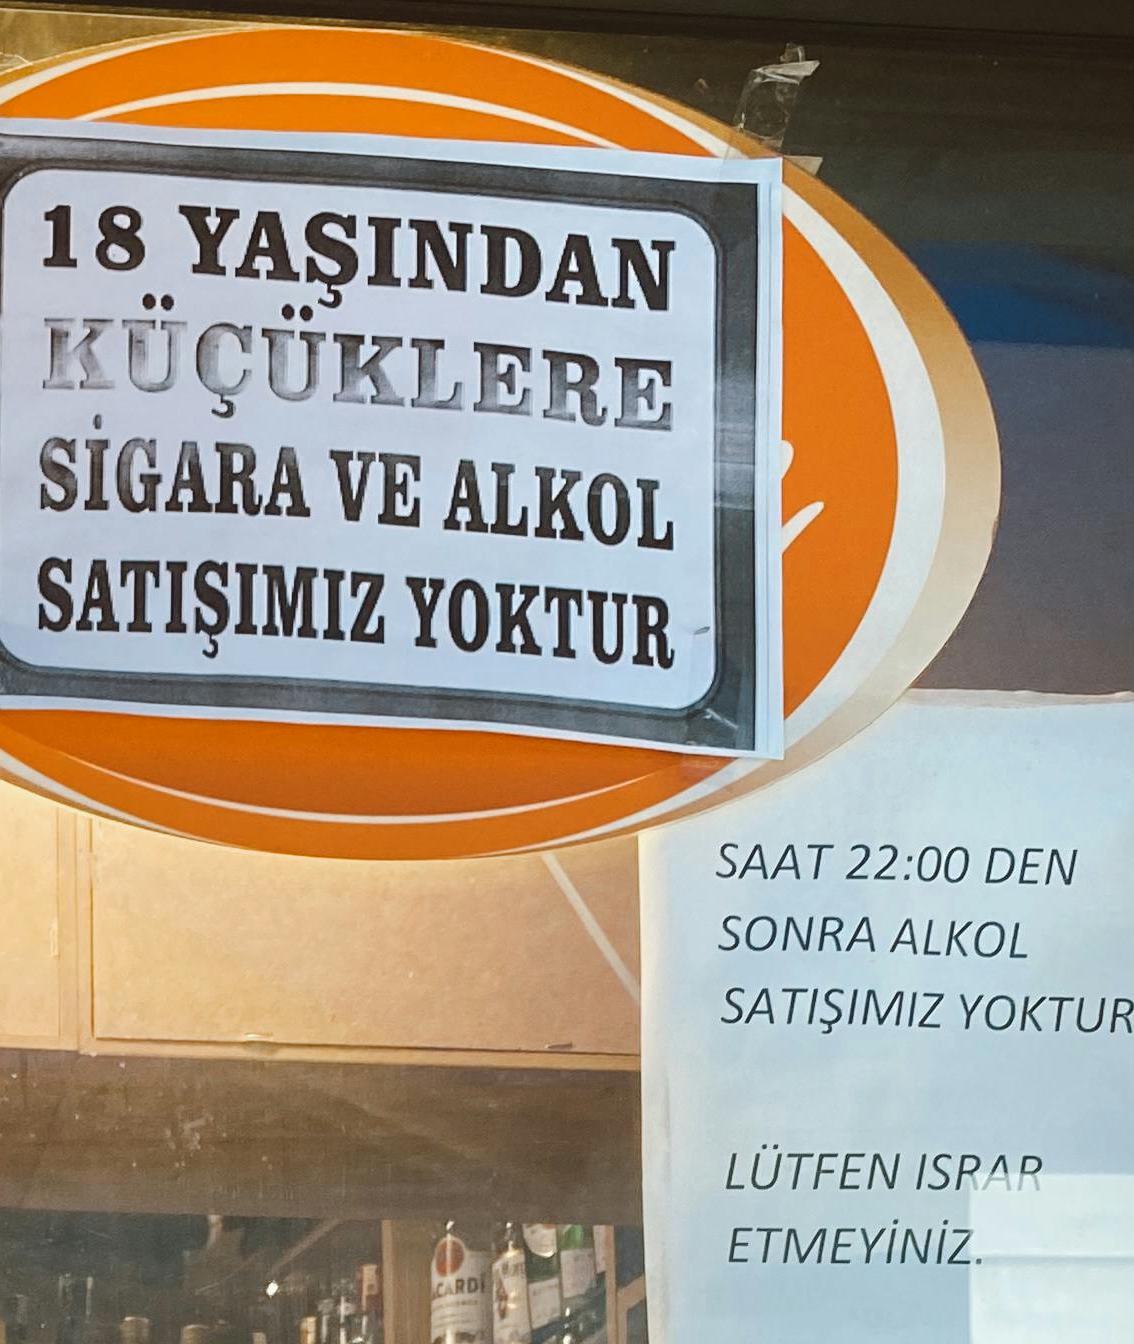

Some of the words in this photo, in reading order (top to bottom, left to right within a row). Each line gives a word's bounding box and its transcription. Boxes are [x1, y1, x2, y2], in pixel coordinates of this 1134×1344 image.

[42, 205, 146, 272] 18
[178, 204, 676, 312] YAŞINDAN
[43, 295, 675, 432] KÜÇÜKLERE
[37, 413, 311, 519] SİGARA
[330, 448, 423, 526] VE
[443, 457, 676, 551] ALKOL
[35, 556, 387, 659] SATIŞIMIZ
[404, 576, 676, 671] YOKTUR
[716, 842, 834, 883] SAAT
[845, 844, 970, 885] 22:00
[984, 847, 1079, 886] DEN
[718, 915, 877, 955] SONRA
[889, 918, 1029, 959] ALKOL
[720, 986, 944, 1036] SATIŞIMIZ
[959, 993, 1134, 1034] YOKTUR
[726, 1143, 902, 1191] LÜTFEN
[915, 1152, 1045, 1192] ISRAR
[728, 1223, 984, 1267] ETMEYİNİZ.
